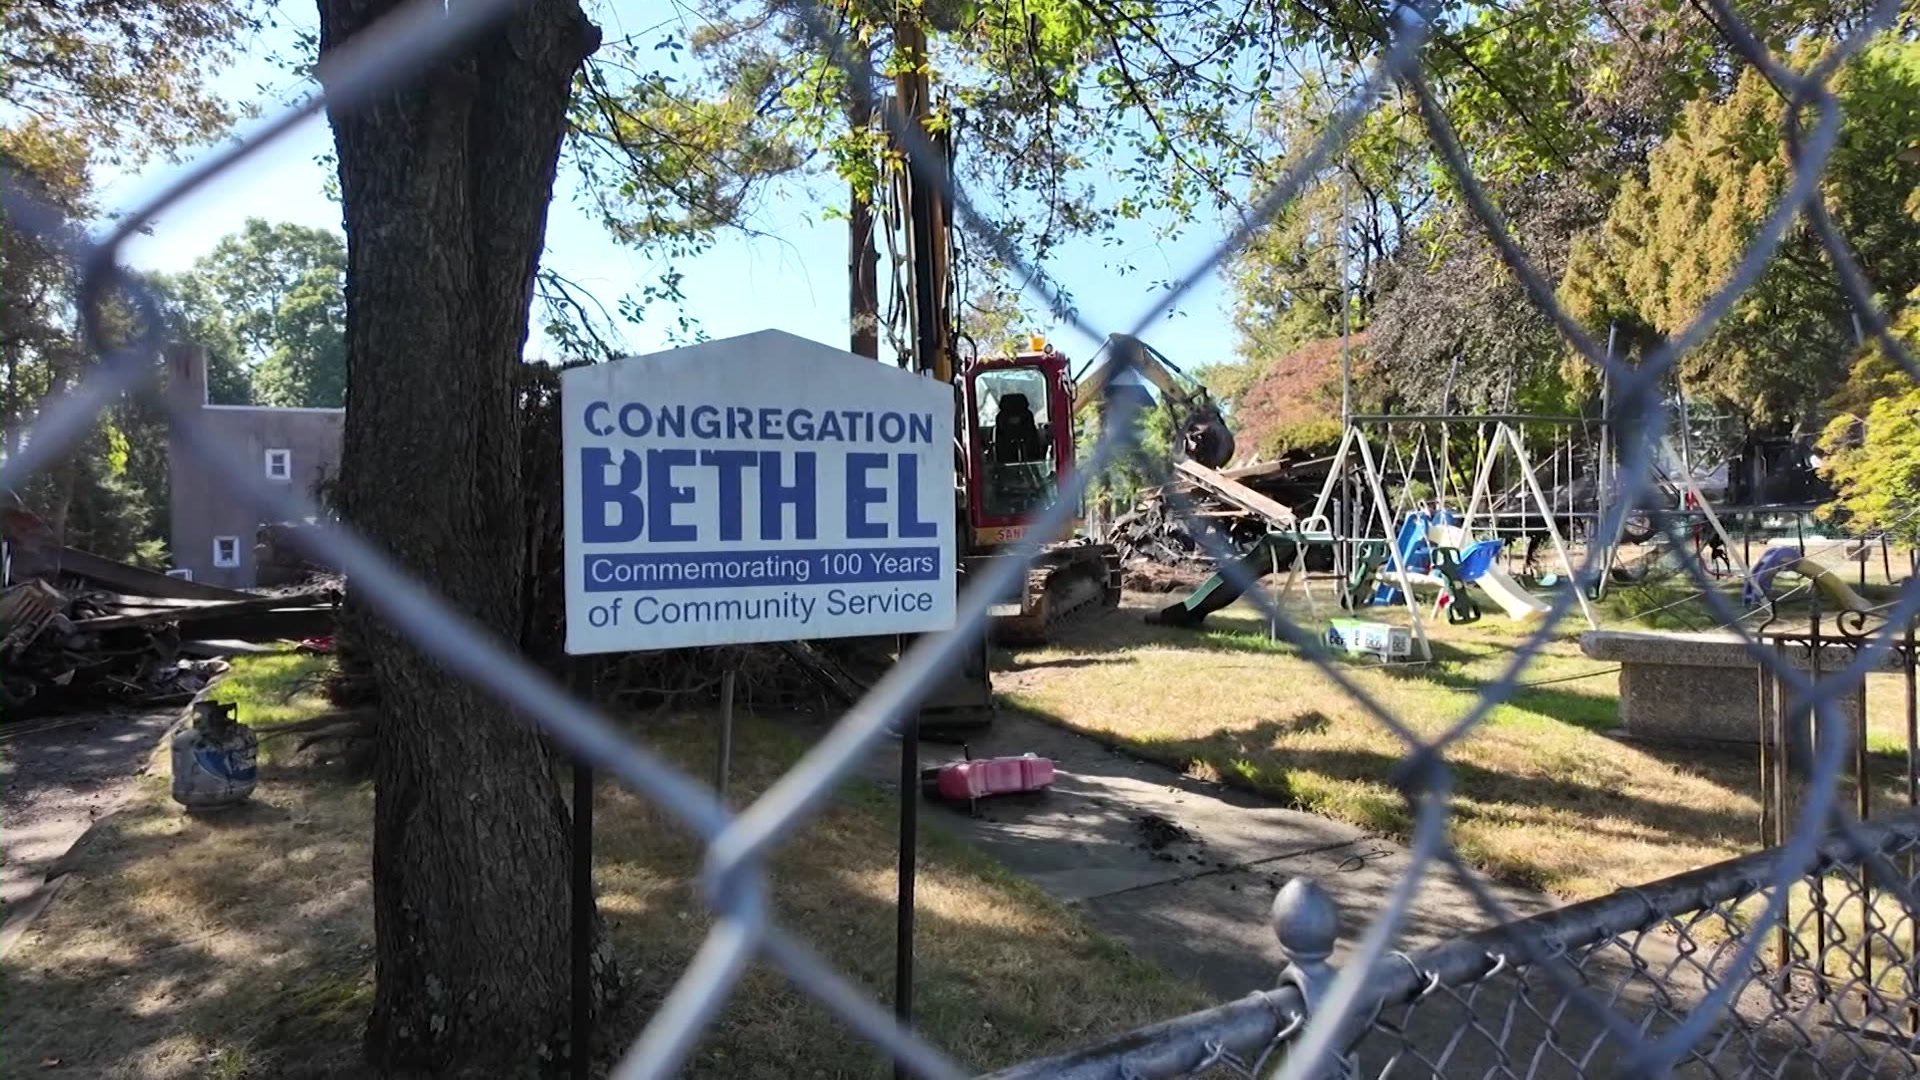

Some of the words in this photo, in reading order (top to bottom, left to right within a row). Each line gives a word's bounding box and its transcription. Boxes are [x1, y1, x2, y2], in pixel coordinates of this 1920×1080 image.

[584, 401, 933, 443] CONGREGATION
[581, 447, 817, 543] BETH
[846, 452, 937, 539] EL
[591, 555, 810, 583] Commemorating
[820, 554, 862, 575] 100
[869, 552, 934, 575] Years
[588, 598, 622, 627] of
[633, 591, 816, 624] Community
[826, 587, 933, 615] Service
